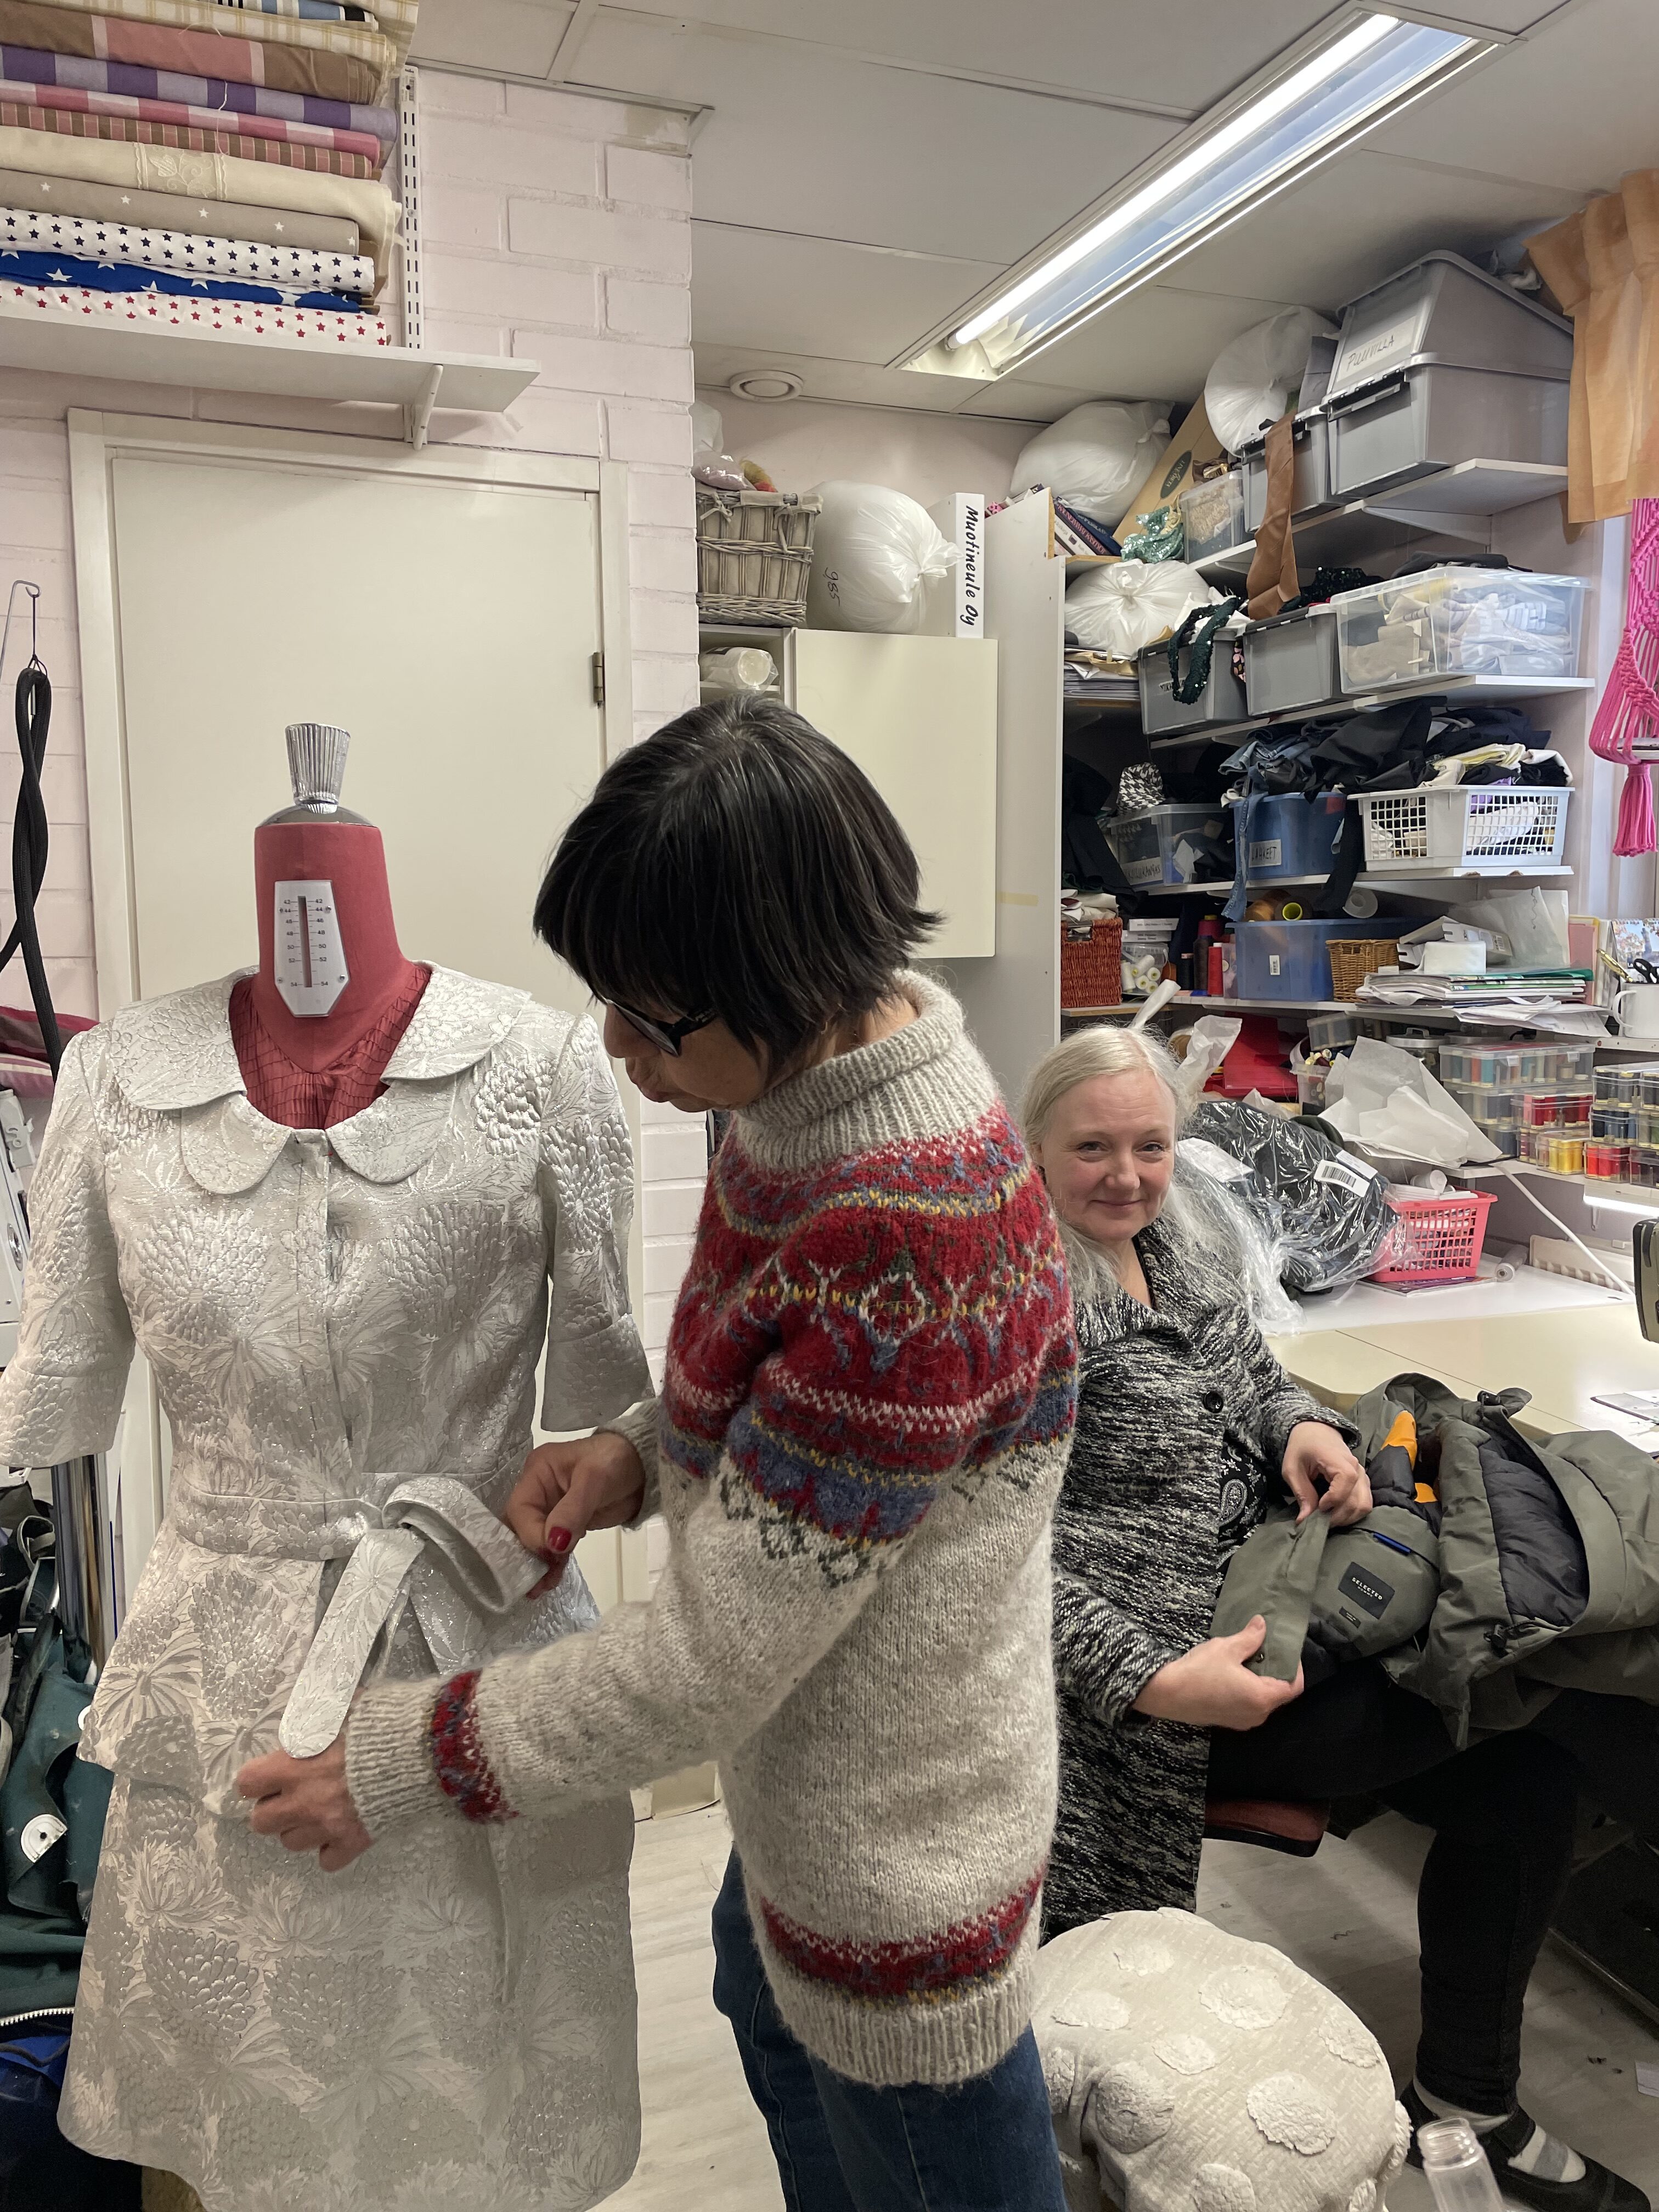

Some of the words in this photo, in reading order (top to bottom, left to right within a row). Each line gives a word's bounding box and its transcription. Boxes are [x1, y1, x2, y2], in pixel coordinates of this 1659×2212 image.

[966, 505, 980, 598] Muotineule
[960, 604, 979, 626] Oy
[1352, 1577, 1383, 1600] SELECTED
